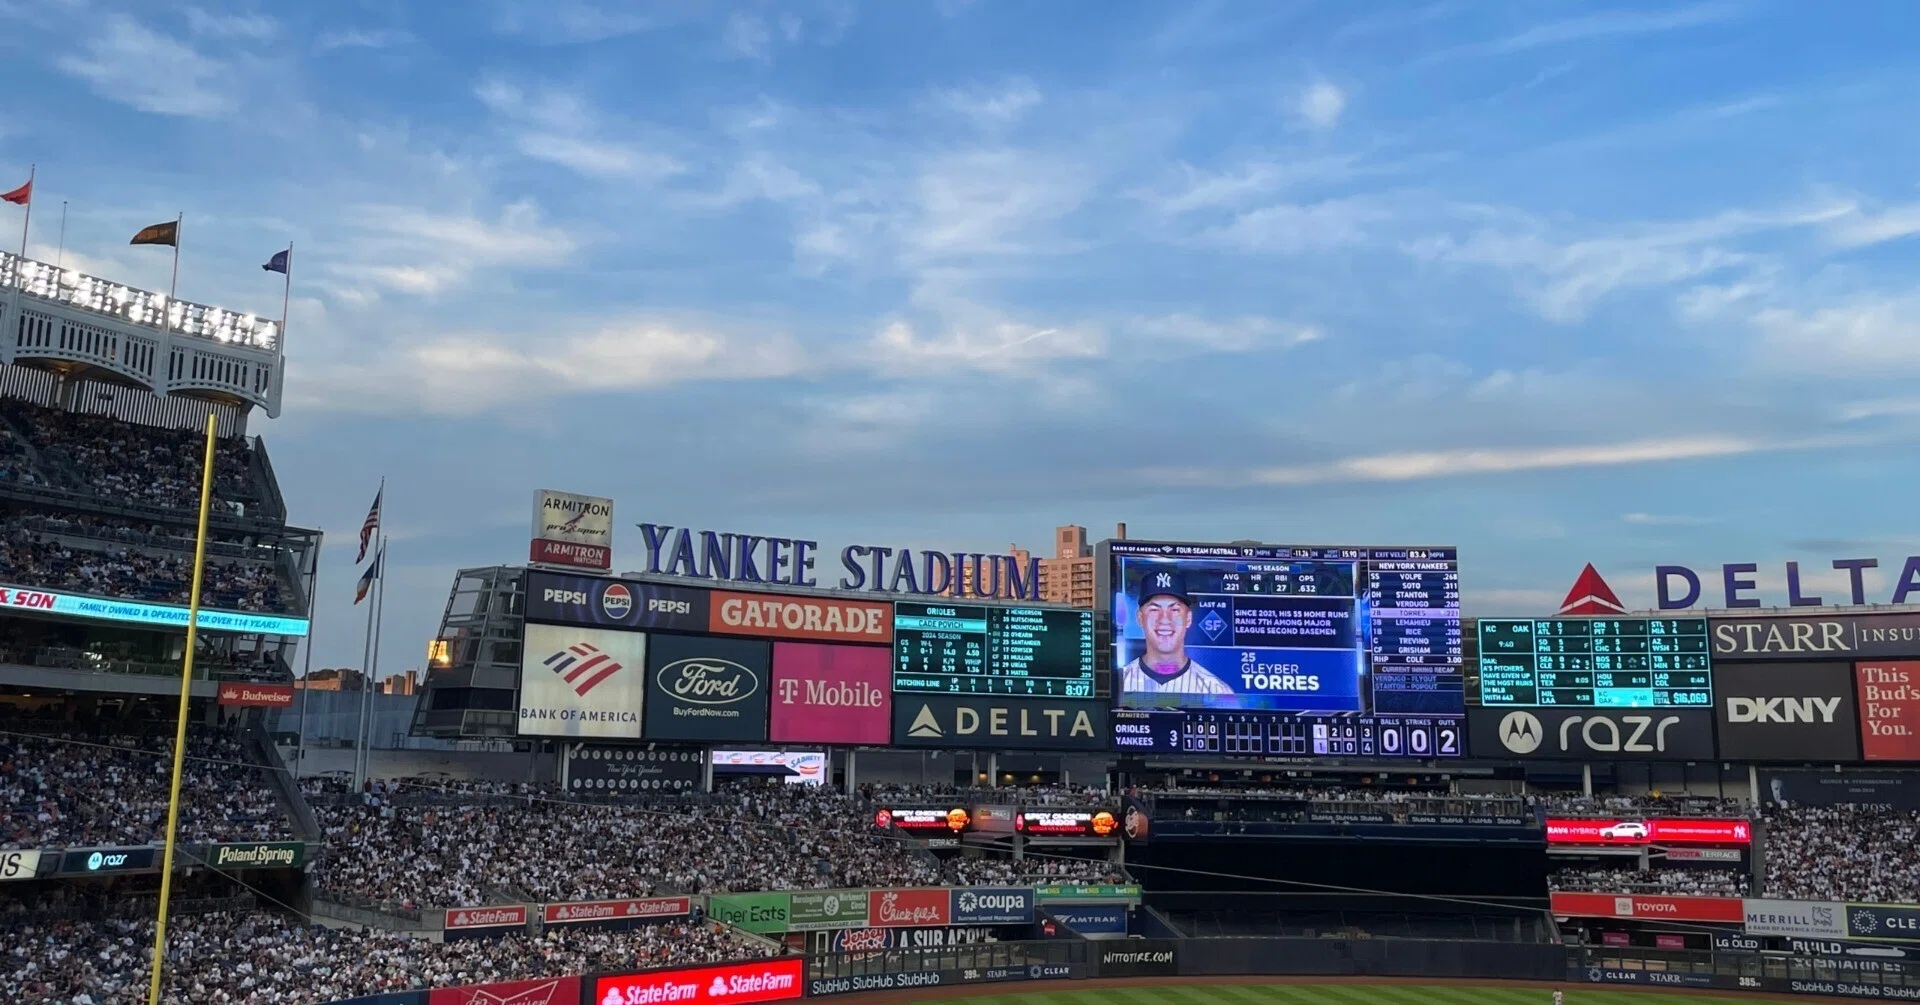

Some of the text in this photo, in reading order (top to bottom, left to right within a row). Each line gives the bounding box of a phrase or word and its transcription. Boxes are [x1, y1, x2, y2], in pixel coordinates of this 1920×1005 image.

[544, 498, 610, 517] ARMITRON
[544, 542, 604, 559] ARMITRON
[1210, 548, 1237, 556] FASTBALL
[573, 556, 602, 566] WATCHES
[636, 523, 1042, 600] YANKEE STADIUM
[1224, 583, 1239, 591] .221
[13, 590, 57, 609] SON
[544, 588, 586, 606] PEPSI
[604, 596, 630, 607] PEPSI
[649, 599, 690, 615] PEPSI
[927, 608, 956, 616] ORIOLES
[1258, 610, 1277, 618] 2021,
[78, 602, 108, 612] FAMILY
[109, 605, 140, 616] OWNED
[211, 615, 233, 625] OVER
[234, 616, 249, 627] 114
[250, 618, 280, 629] YEARS!
[721, 599, 883, 634] GATORADE
[1258, 618, 1272, 626] 7TH
[1304, 619, 1331, 627] MAJOR
[919, 619, 963, 629] CADE POVICH
[1205, 620, 1222, 631] SF
[1715, 622, 1920, 653] STARR INSU
[1241, 652, 1256, 663] 25
[1241, 663, 1299, 675] GLEYBER
[1862, 667, 1909, 683] This
[674, 663, 740, 697] Ford
[897, 678, 925, 687] PITCHING
[1241, 674, 1320, 690] TORRES
[241, 690, 292, 702] Budweiser
[779, 679, 882, 707] T Mobile
[1065, 685, 1090, 697] 8:07
[1865, 685, 1920, 700] Bud's
[521, 709, 638, 723] BANK OF AMERICA
[673, 707, 739, 718] BuyFordNow.com
[1727, 697, 1841, 723] DKNY
[1866, 702, 1901, 718] For
[957, 707, 1095, 737] DELTA
[1115, 724, 1150, 734] ORIOLES
[1867, 720, 1912, 735] You.
[1115, 730, 1178, 746] YANKEES 3
[1383, 729, 1455, 752] 0 0 2
[1560, 716, 1680, 752] razr
[1547, 826, 1599, 835] RAV4 HYBRID
[929, 839, 958, 847] TERRACE
[102, 854, 128, 865] razr
[218, 846, 295, 865] Poland Spring
[1701, 851, 1739, 859] TERRACE
[880, 900, 940, 922] Chick-fil-A
[978, 895, 1024, 913] coupa
[1635, 902, 1677, 913] TOYOTA
[750, 905, 786, 923] Eats
[1747, 912, 1810, 926] MERRILL
[1716, 939, 1758, 949] LG OLED
[1103, 951, 1173, 964] NITTOTIRE.COM
[964, 969, 977, 979] 399
[1606, 971, 1637, 980] CLEAR
[1649, 973, 1681, 983] STARR
[813, 971, 940, 995] StubHub StubHub StubHub
[1739, 977, 1756, 987] 385
[1791, 981, 1879, 996] StubHub StubHub
